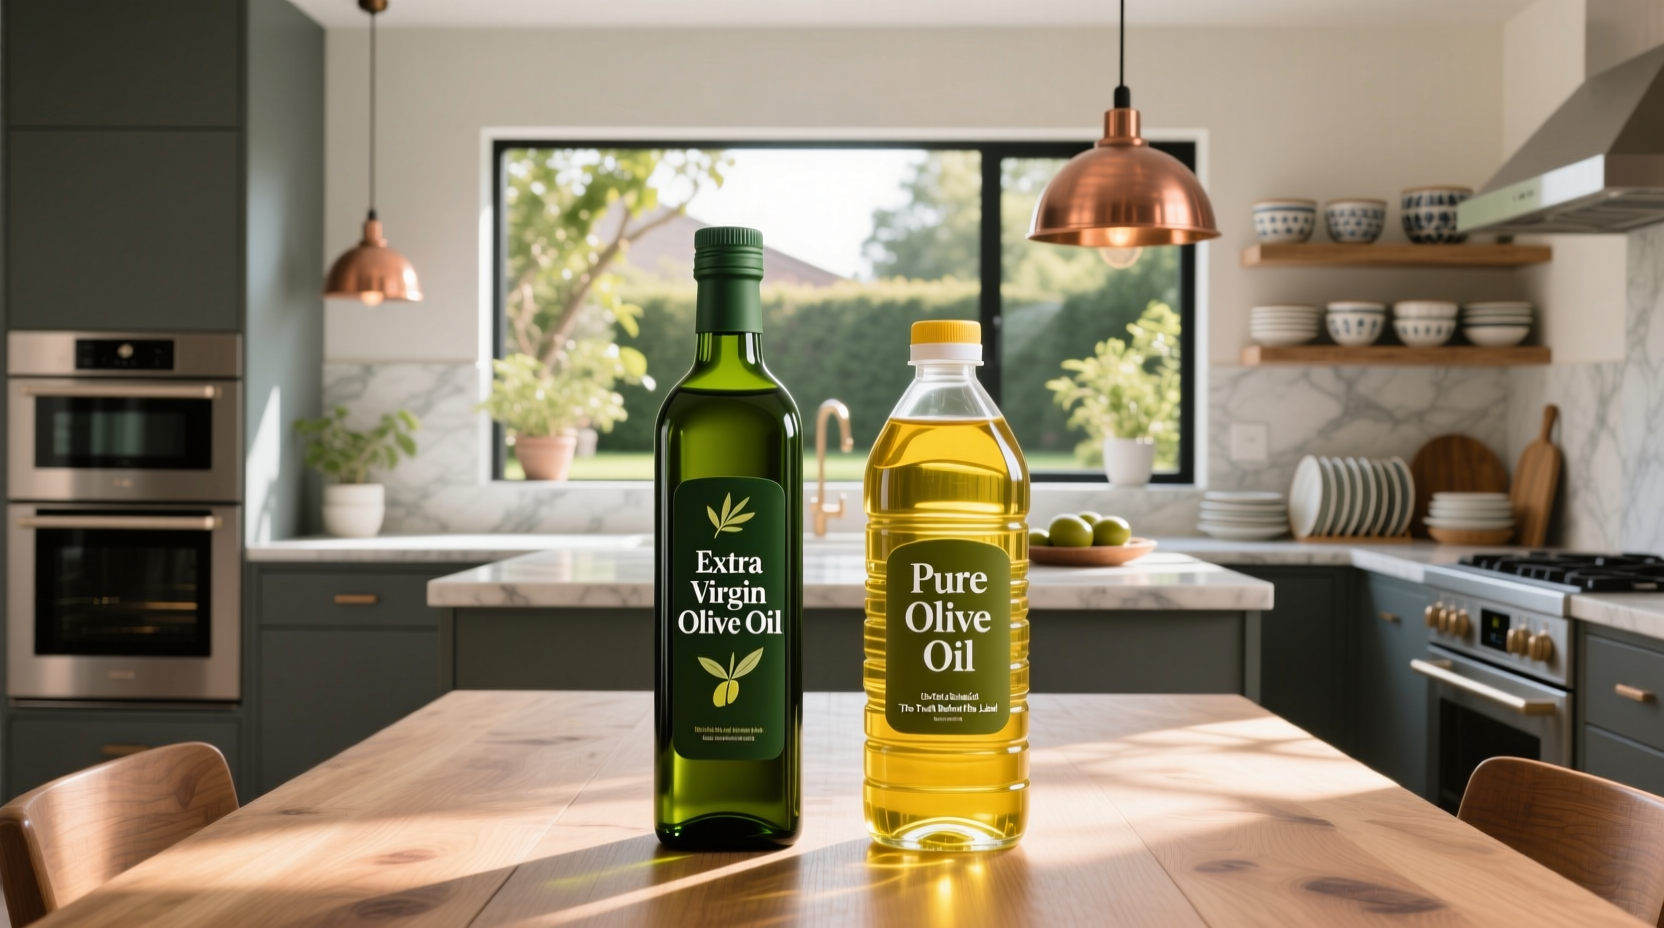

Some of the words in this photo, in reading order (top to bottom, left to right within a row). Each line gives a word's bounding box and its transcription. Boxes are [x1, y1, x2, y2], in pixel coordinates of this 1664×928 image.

[695, 550, 763, 574] Extra
[910, 562, 988, 594] Pure
[690, 580, 767, 611] Virgin
[677, 609, 741, 635] Olive
[745, 609, 783, 635] Oil
[904, 601, 992, 633] Olive
[923, 639, 976, 673] Oil
